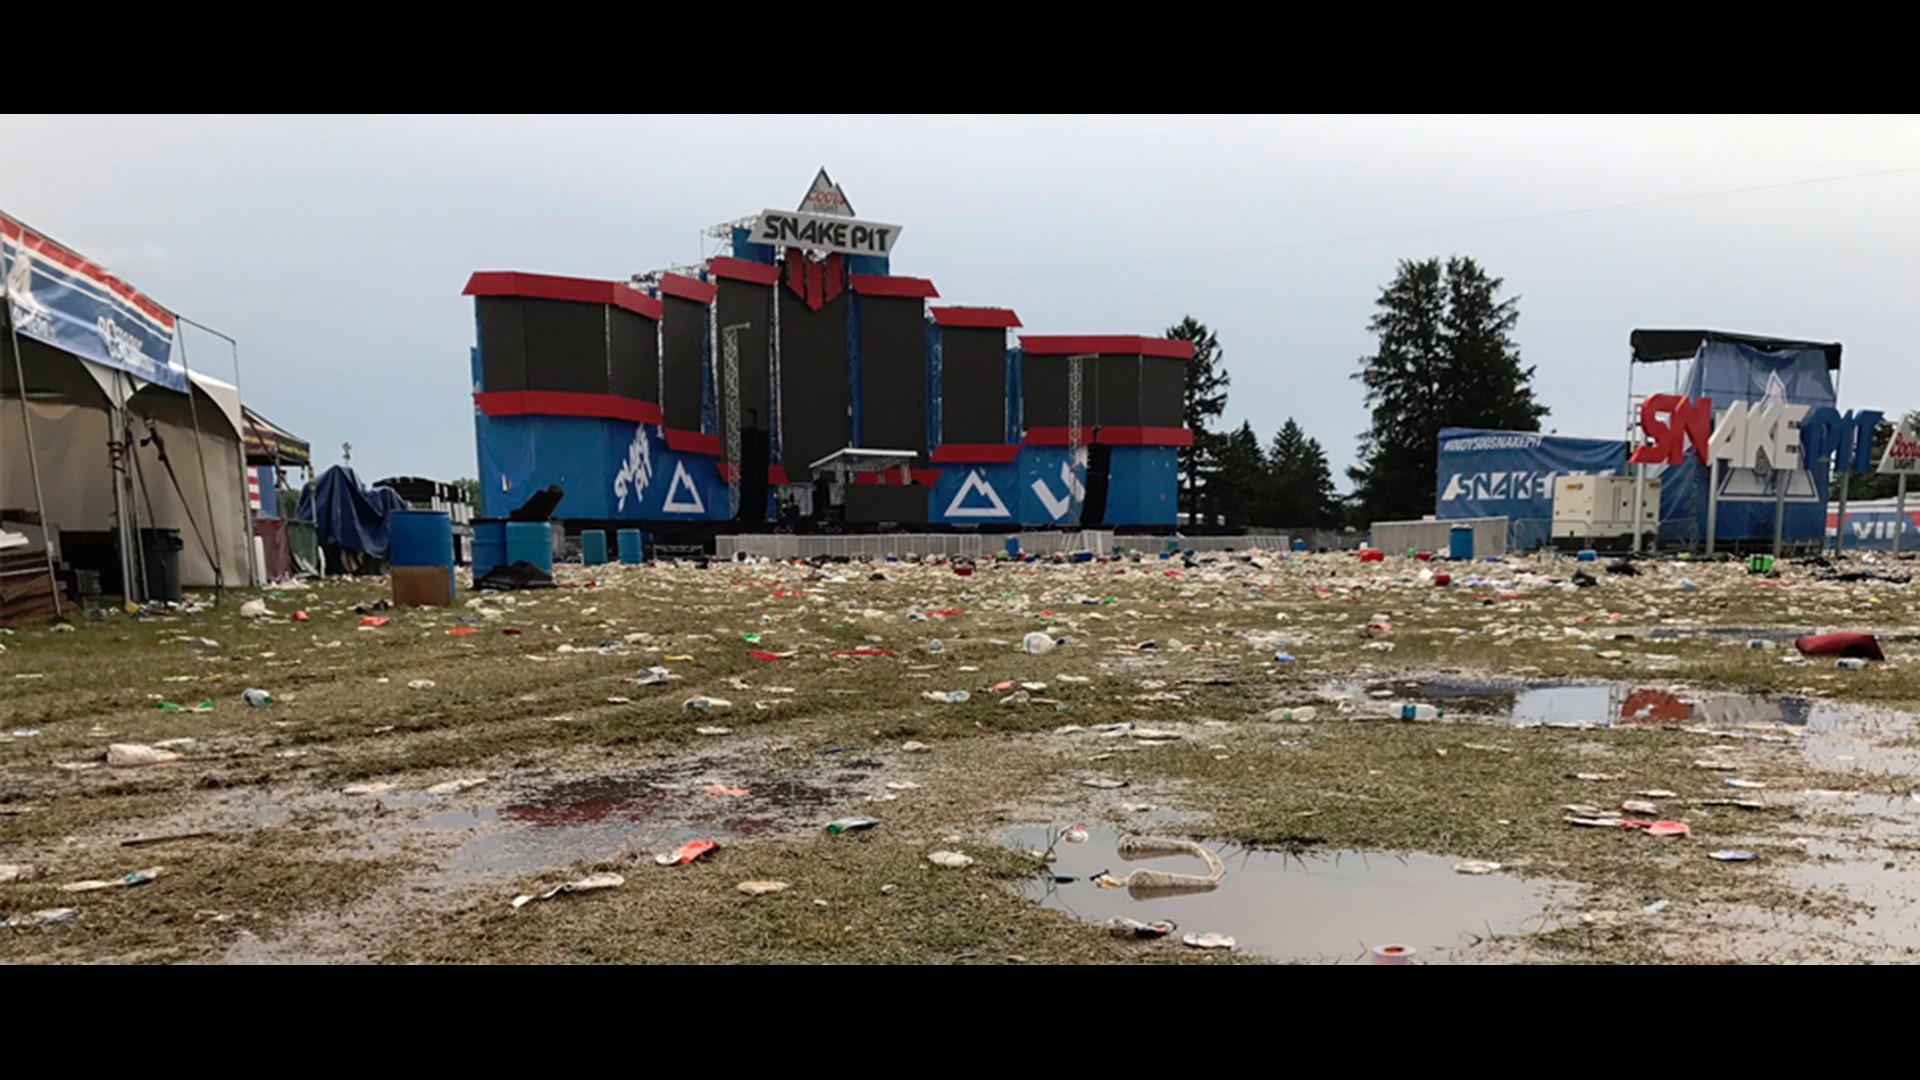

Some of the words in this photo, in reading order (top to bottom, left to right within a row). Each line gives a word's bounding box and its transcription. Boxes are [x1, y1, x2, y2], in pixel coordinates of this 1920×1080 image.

[762, 215, 848, 246] SNAKE
[851, 225, 891, 251] PIT
[1629, 393, 1810, 469] SNAKE
[1804, 407, 1884, 473] PIT
[1893, 458, 1916, 470] LIGHT
[1456, 471, 1547, 500] SNAKE
[1852, 521, 1907, 539] VIP
